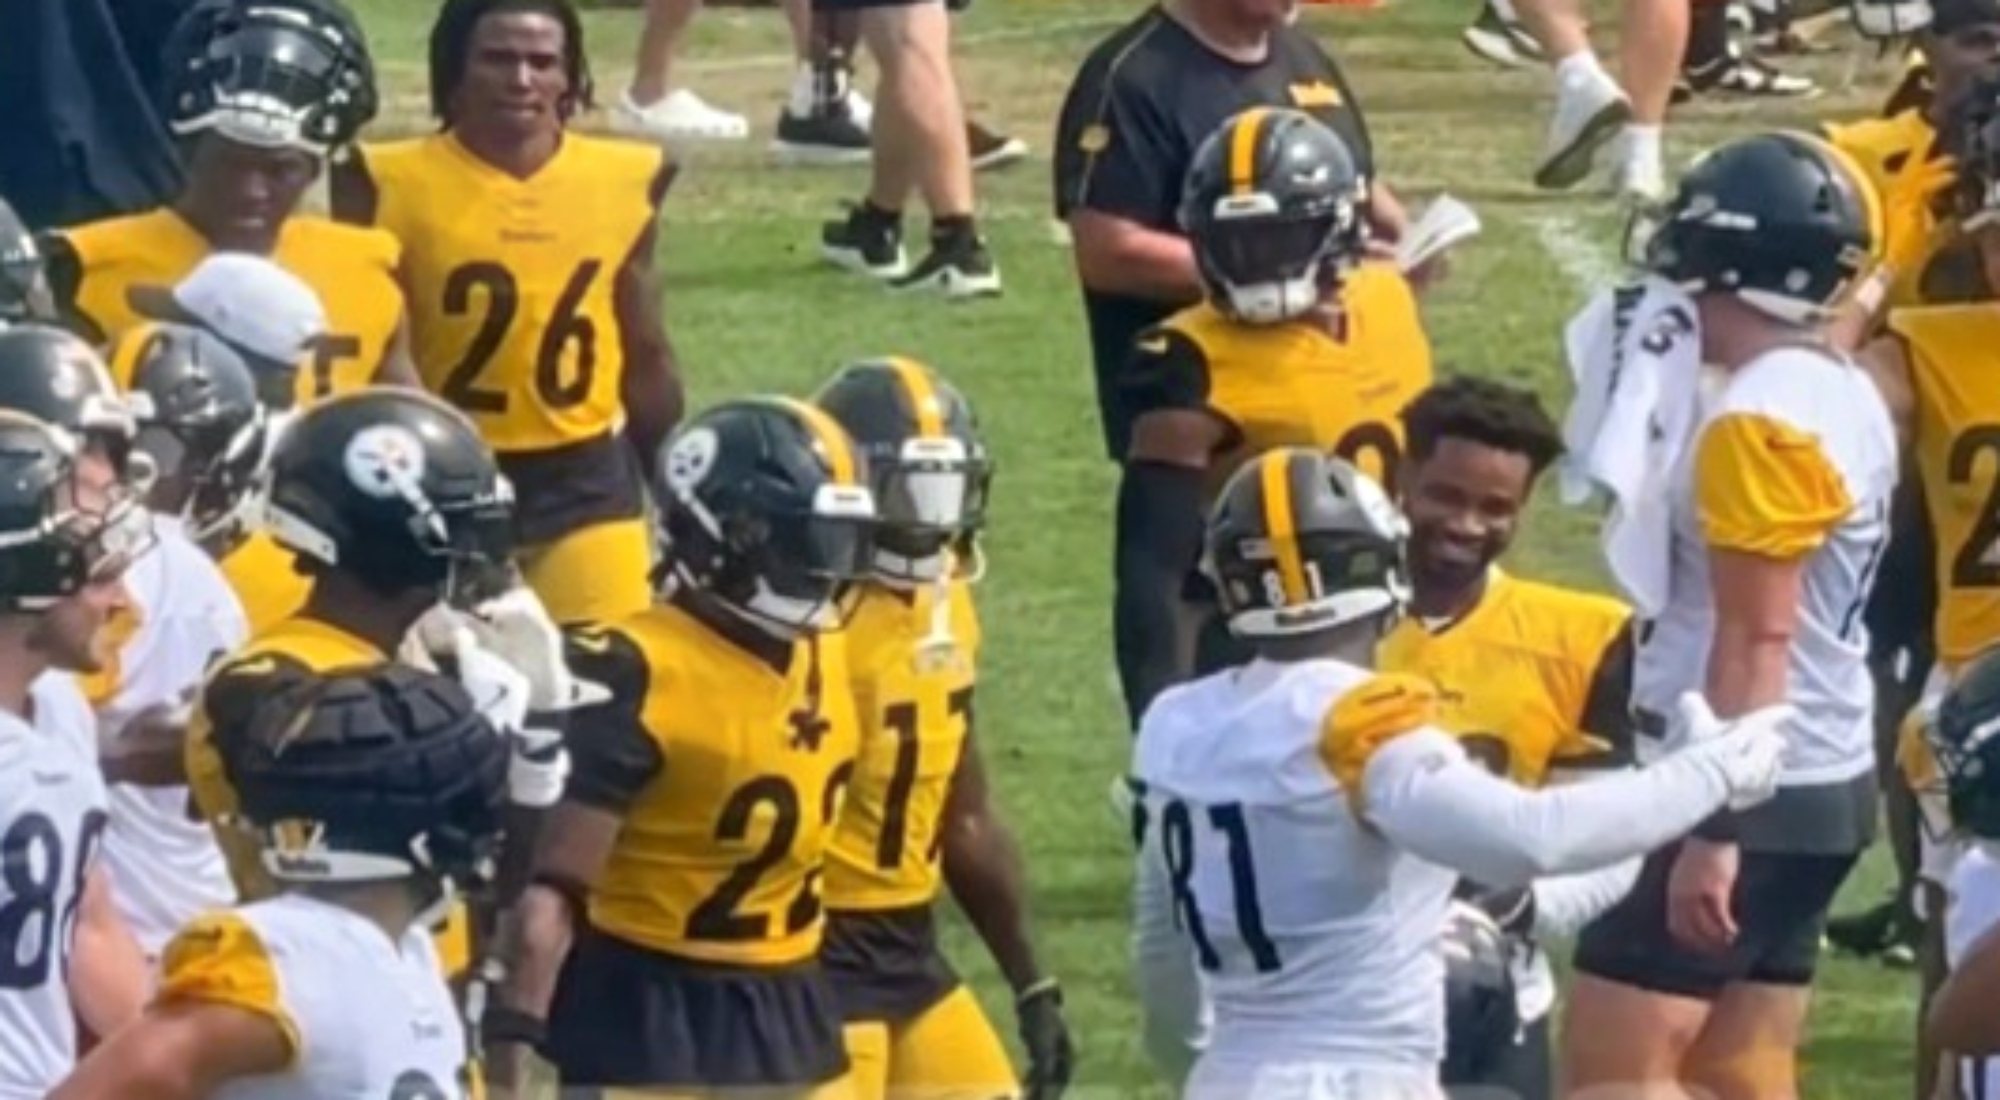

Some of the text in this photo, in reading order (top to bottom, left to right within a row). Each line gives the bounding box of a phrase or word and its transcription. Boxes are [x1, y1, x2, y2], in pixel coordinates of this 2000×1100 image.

[442, 257, 602, 414] 26
[1262, 561, 1324, 608] 81
[1162, 798, 1282, 970] 81
